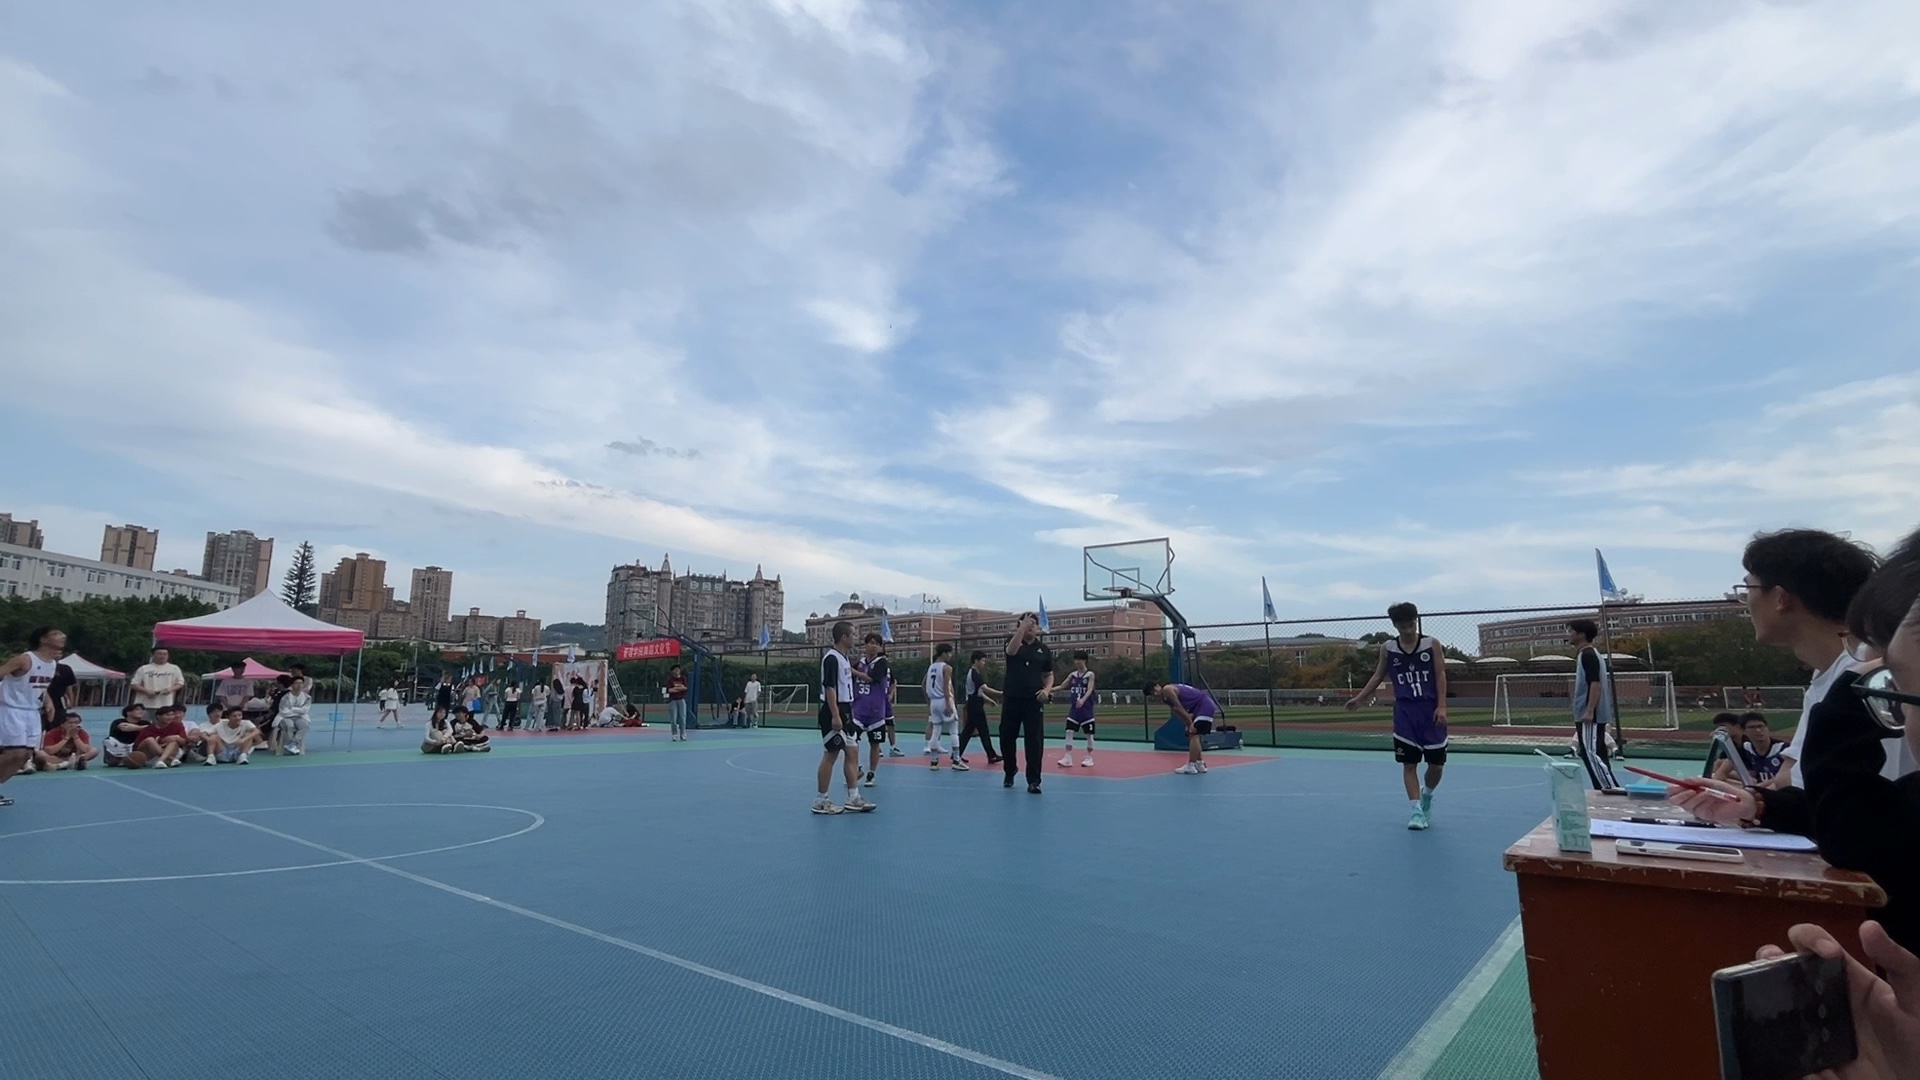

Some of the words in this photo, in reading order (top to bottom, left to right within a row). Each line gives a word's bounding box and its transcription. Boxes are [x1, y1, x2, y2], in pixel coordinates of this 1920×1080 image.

[931, 674, 936, 689] 7
[1397, 670, 1429, 685] CUIT
[858, 684, 871, 695] 35
[1410, 683, 1423, 698] 11
